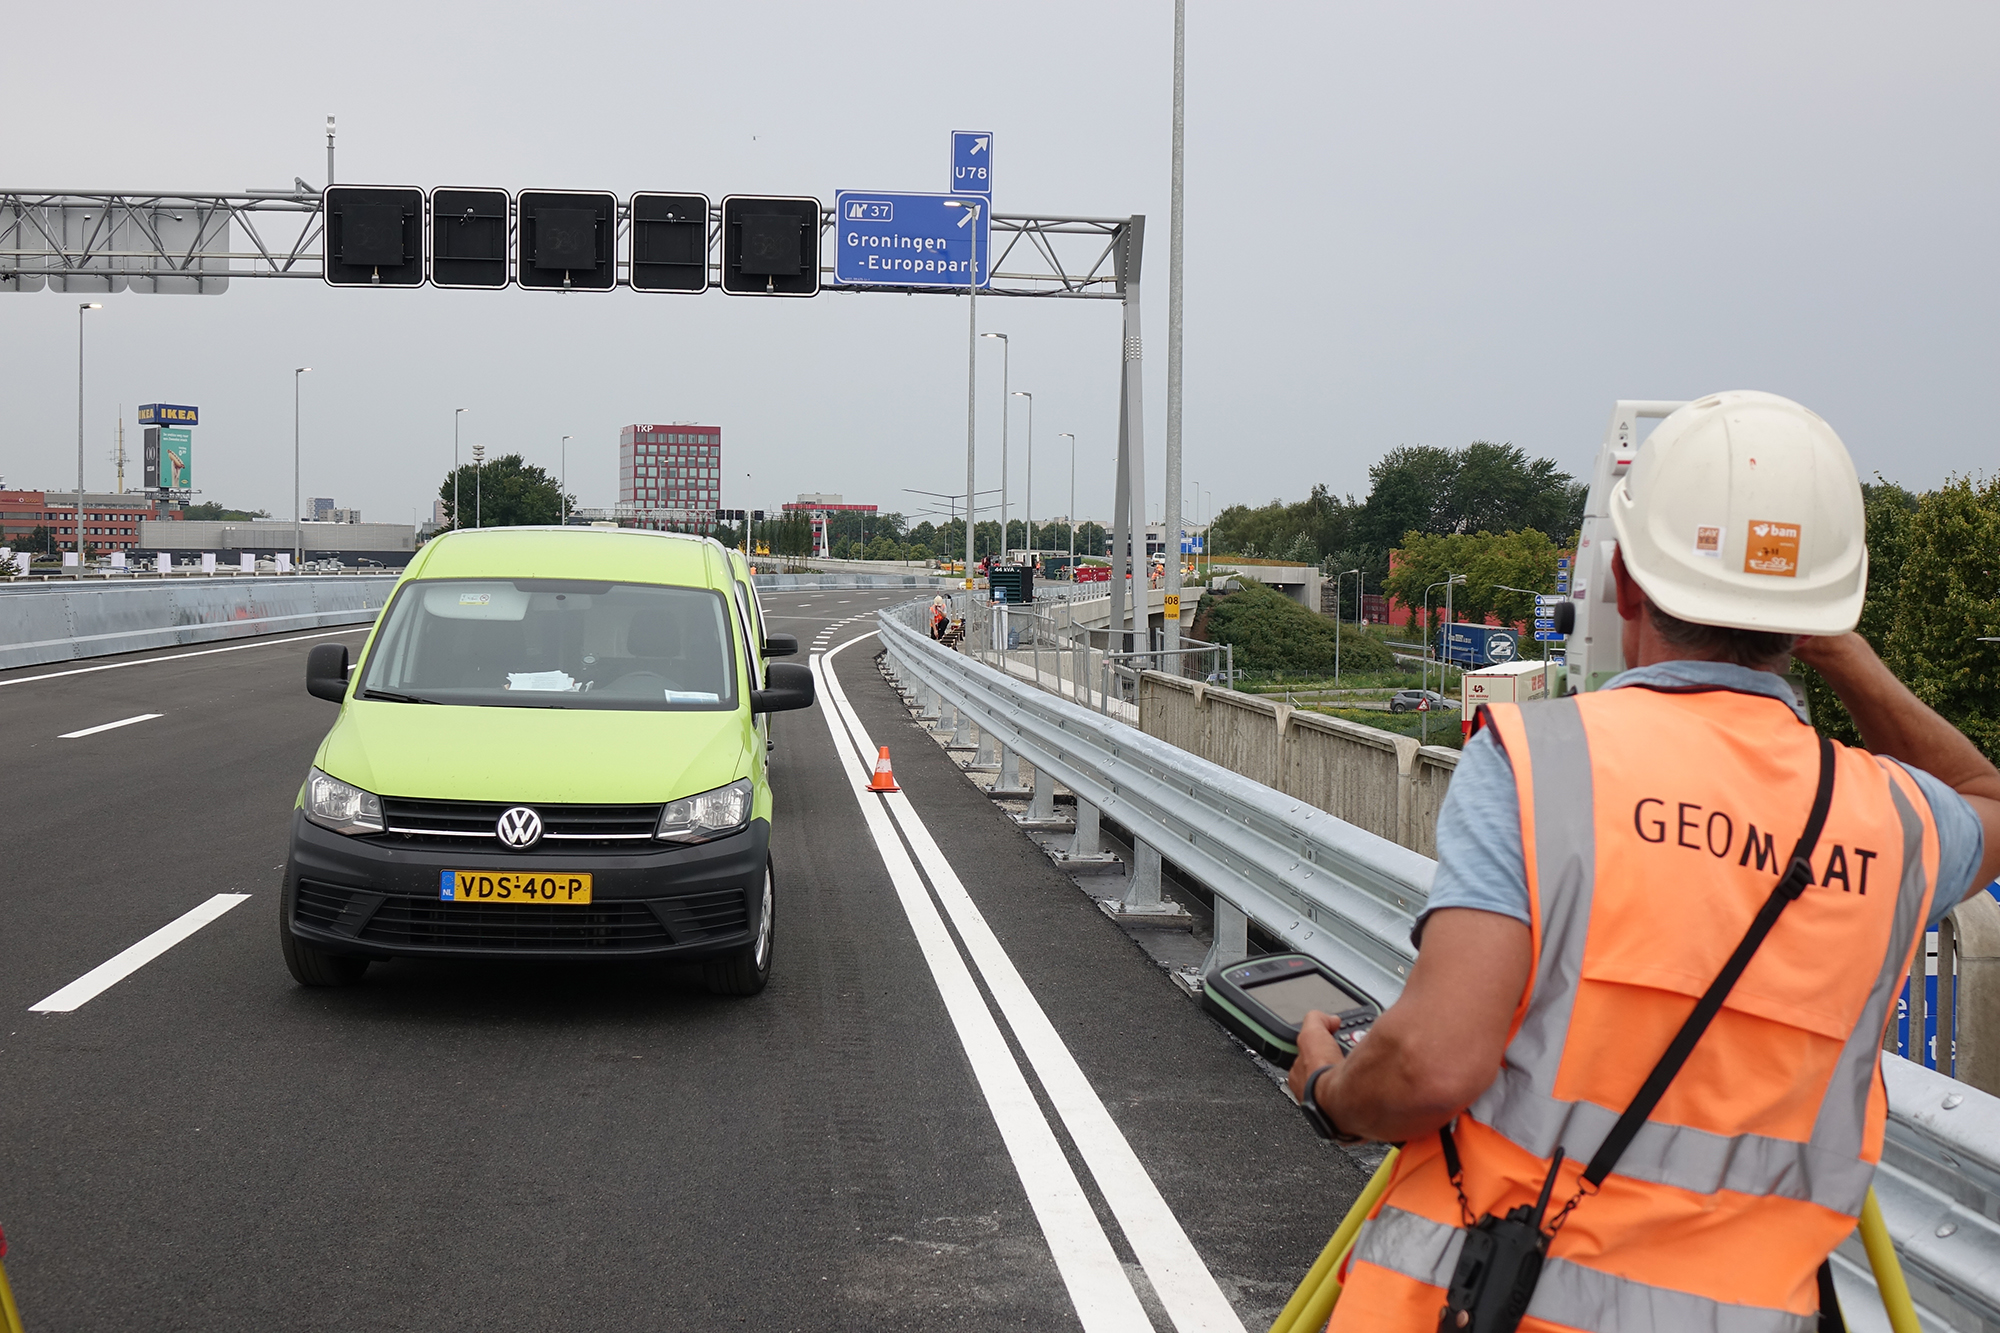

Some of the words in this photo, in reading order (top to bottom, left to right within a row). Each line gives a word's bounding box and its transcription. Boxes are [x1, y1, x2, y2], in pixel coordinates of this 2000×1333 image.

[955, 166, 988, 180] U78
[870, 206, 889, 217] 37
[847, 232, 947, 253] Groningen
[161, 408, 197, 421] IKEA
[636, 424, 654, 433] TKP
[1771, 524, 1797, 538] bam
[498, 807, 541, 847] VW
[1634, 797, 1878, 896] GEOMAT
[442, 889, 453, 897] NL
